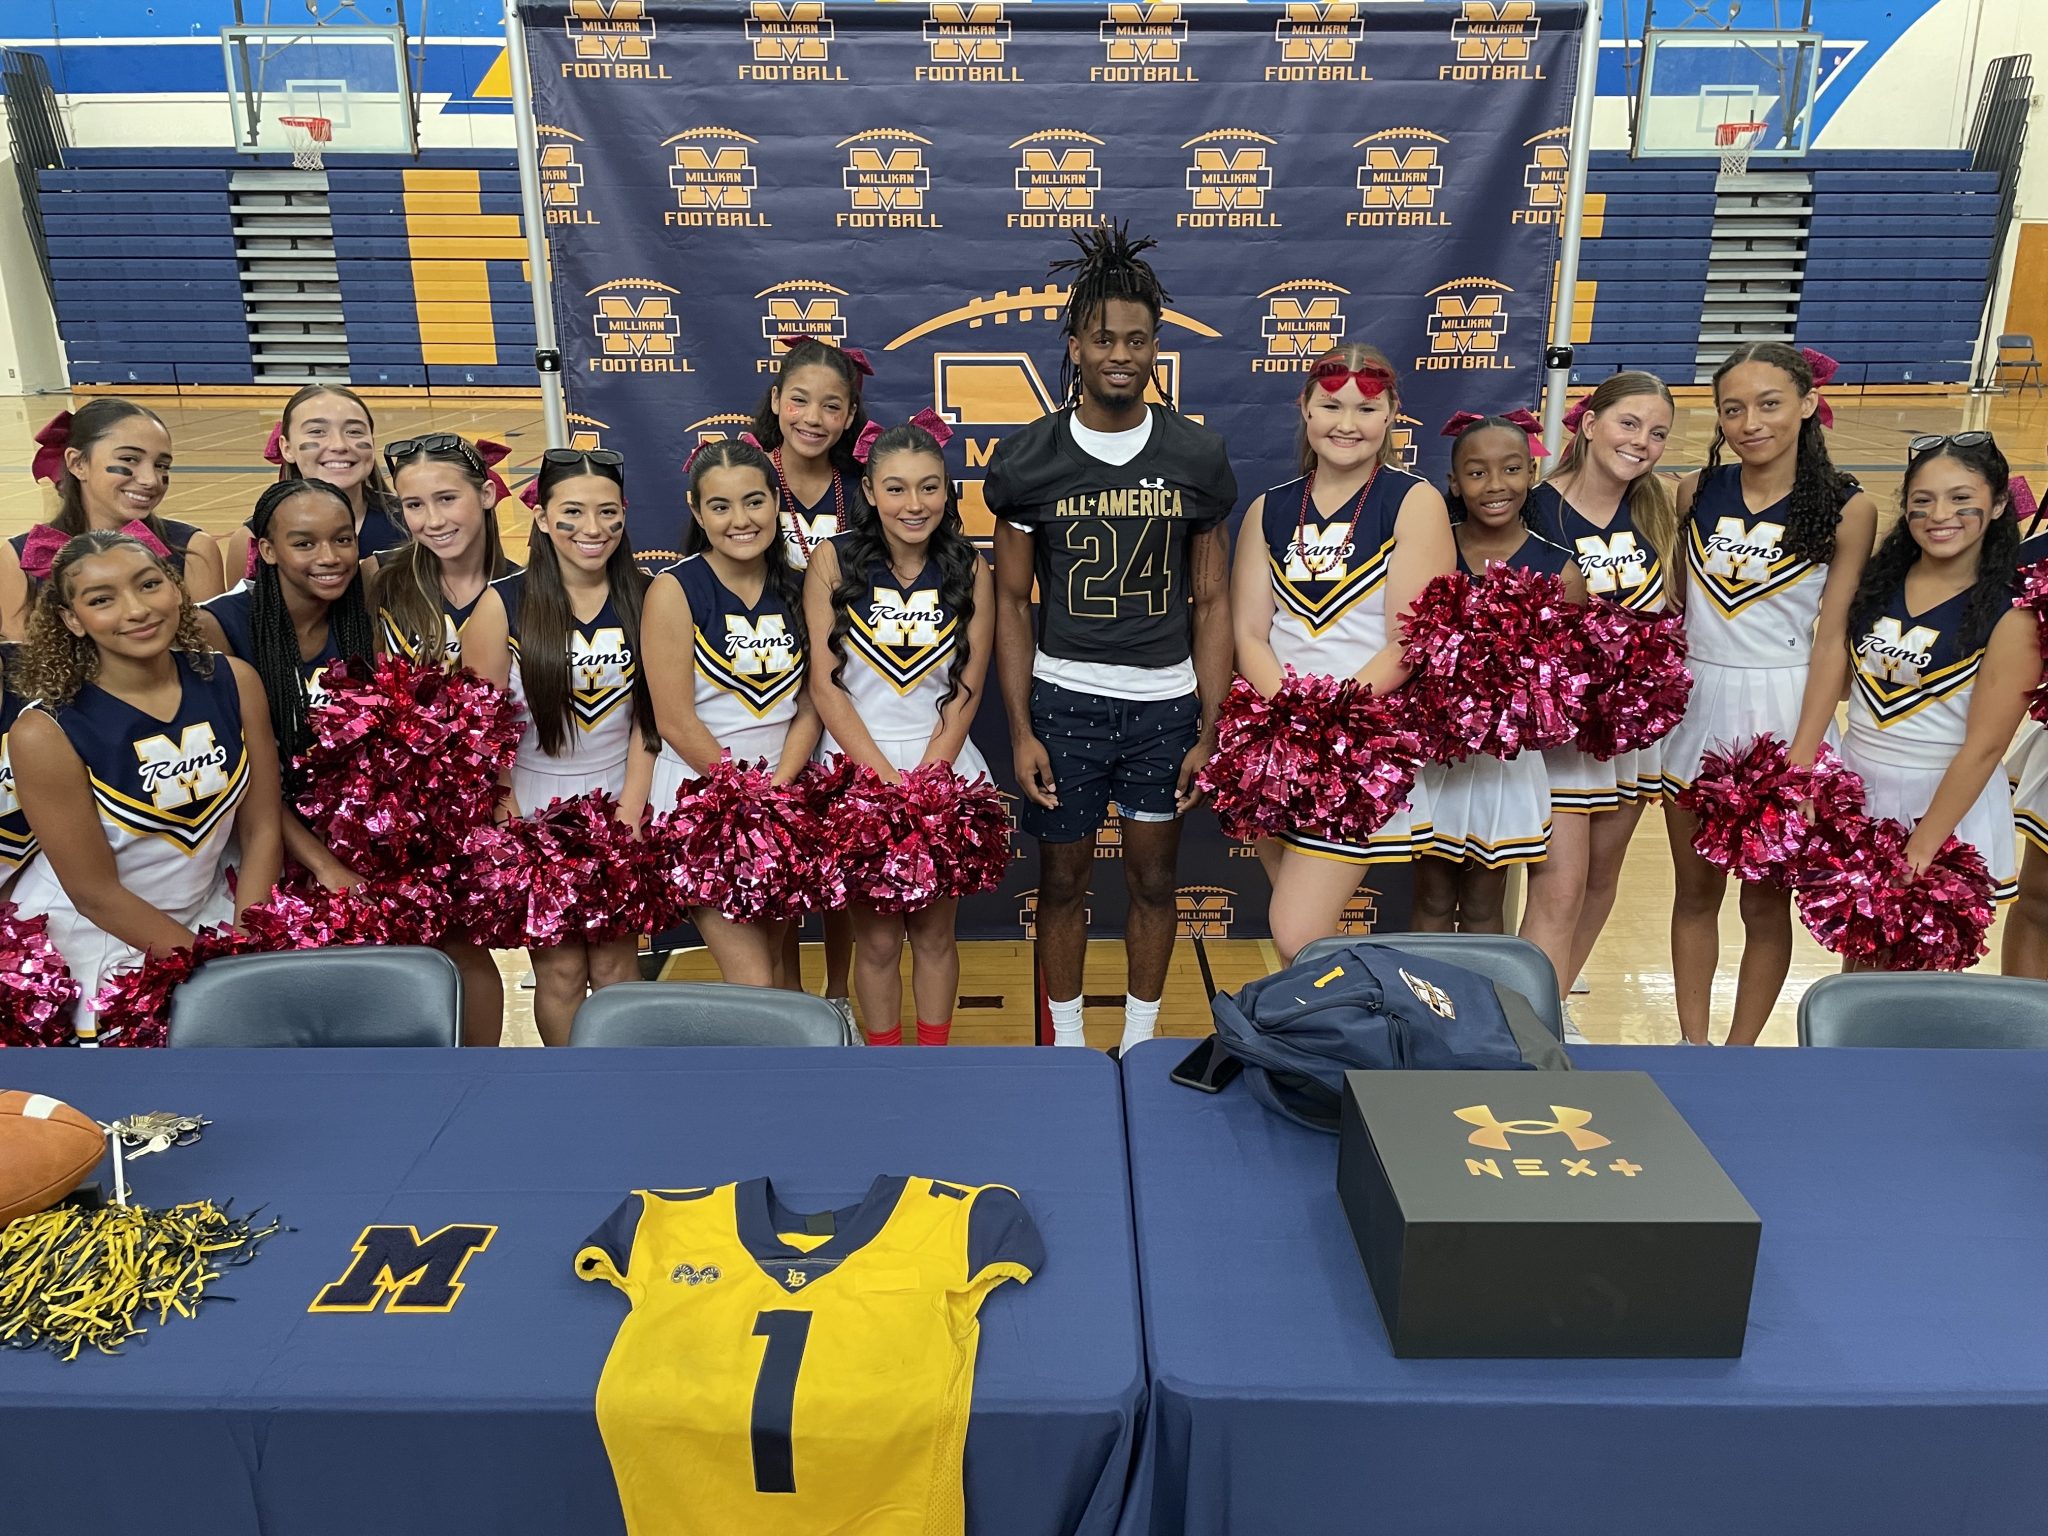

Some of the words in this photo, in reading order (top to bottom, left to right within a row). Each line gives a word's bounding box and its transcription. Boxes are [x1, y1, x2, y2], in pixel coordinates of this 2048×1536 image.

[564, 0, 656, 61] M
[582, 19, 641, 33] MILLIKAN
[744, 0, 835, 64] M
[761, 21, 819, 35] MILLIKAN
[922, 1, 1012, 65] M
[939, 23, 996, 36] MILLIKAN
[1100, 2, 1188, 65] M
[1115, 23, 1173, 36] MILLIKAN
[1275, 2, 1364, 64] M
[1291, 22, 1348, 36] MILLIKAN
[1451, 1, 1541, 64] M
[1467, 21, 1524, 35] MILLIKAN
[561, 63, 672, 80] FOOTBALL
[738, 65, 849, 81] FOOTBALL
[915, 66, 1024, 82] FOOTBALL
[1090, 66, 1199, 83] FOOTBALL
[1265, 65, 1373, 82] FOOTBALL
[1439, 63, 1547, 81] FOOTBALL
[542, 169, 567, 180] IKAN
[669, 146, 757, 211] M
[685, 170, 742, 184] MILLIKAN
[843, 148, 931, 212] M
[859, 172, 914, 185] MILLIKAN
[1015, 148, 1101, 212] M
[1031, 174, 1086, 184] MILLIKAN
[1186, 147, 1272, 211] M
[1202, 172, 1257, 184] MILLIKAN
[1357, 146, 1443, 210] M
[1373, 171, 1428, 183] MILLIKAN
[546, 209, 600, 224] BALL
[664, 211, 772, 227] FOOTBALL
[836, 212, 943, 228] FOOTBALL
[1007, 213, 1113, 228] FOOTBALL
[1176, 212, 1282, 228] FOOTBALL
[1346, 211, 1451, 227] FOOTBALL
[1512, 210, 1561, 224] FOOT
[593, 296, 680, 356] M
[609, 320, 665, 333] MILLIKAN
[762, 298, 847, 355] M
[778, 322, 832, 333] MILLIKAN
[1262, 297, 1345, 358] M
[1277, 321, 1331, 332] MILLIKAN
[1427, 294, 1508, 354] M
[1441, 317, 1493, 330] MILLIKAN
[590, 358, 695, 373] FOOTBALL
[1251, 359, 1314, 373] FOOTB
[1416, 354, 1515, 371] FOOTBALL
[1056, 494, 1090, 517] ALL
[1097, 489, 1183, 517] AMERICA
[779, 512, 838, 570] M
[1702, 516, 1786, 584] M
[1705, 535, 1781, 561] Rams
[1285, 522, 1353, 581] M
[1066, 517, 1171, 618] 24
[1575, 531, 1647, 594] M
[1579, 550, 1645, 574] Rams
[870, 605, 942, 625] Rams
[872, 587, 940, 647] M
[725, 614, 794, 675] M
[726, 633, 793, 655] Rams
[1858, 634, 1931, 667] Rams
[1858, 616, 1940, 689] M
[566, 628, 625, 690] M
[133, 721, 228, 810] M
[141, 747, 226, 790] Rams
[1342, 911, 1364, 919] IKAN
[308, 1224, 498, 1313] M
[752, 1309, 813, 1493] 1
